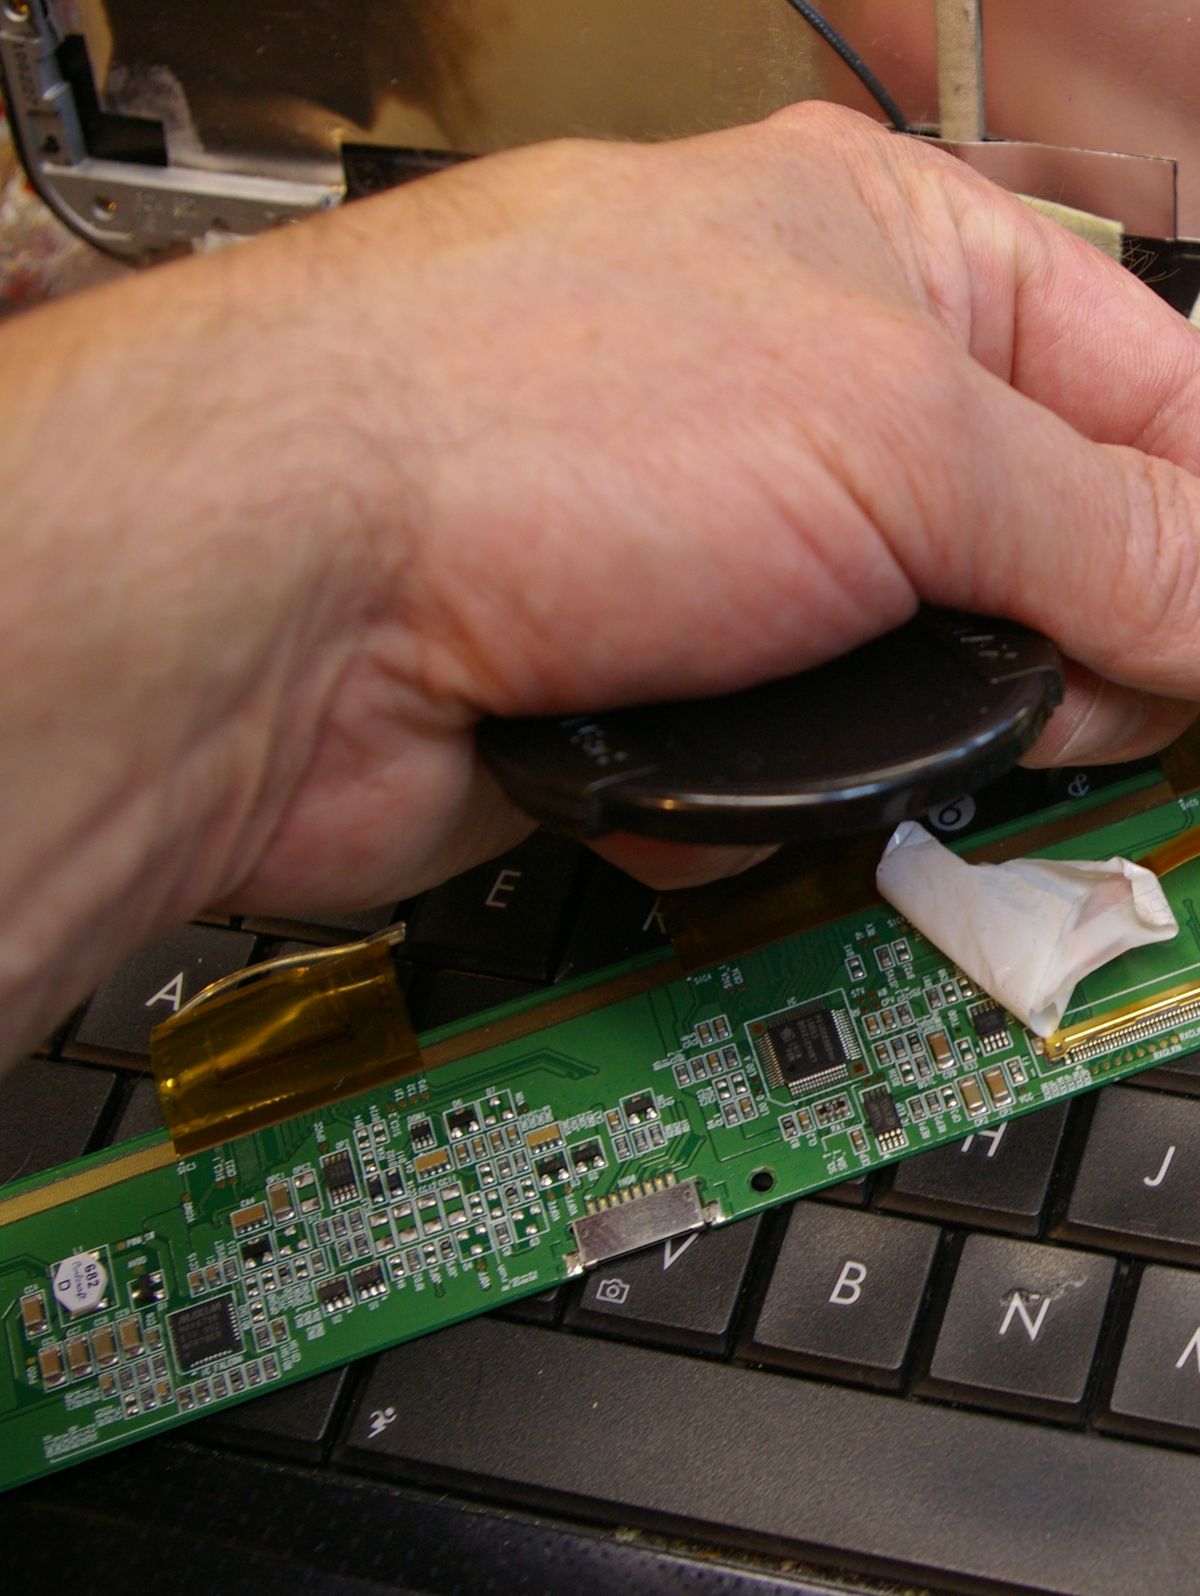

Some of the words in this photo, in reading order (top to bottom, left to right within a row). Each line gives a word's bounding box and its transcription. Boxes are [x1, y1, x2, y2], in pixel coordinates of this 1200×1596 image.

[1067, 774, 1090, 797] &
[484, 869, 521, 908] E
[145, 971, 184, 1012] A
[960, 1121, 1008, 1157] H
[1143, 1145, 1176, 1188] J
[664, 1231, 700, 1273] V
[57, 1278, 70, 1293] D
[84, 1264, 100, 1289] 682
[828, 1260, 868, 1306] B
[998, 1292, 1052, 1342] N
